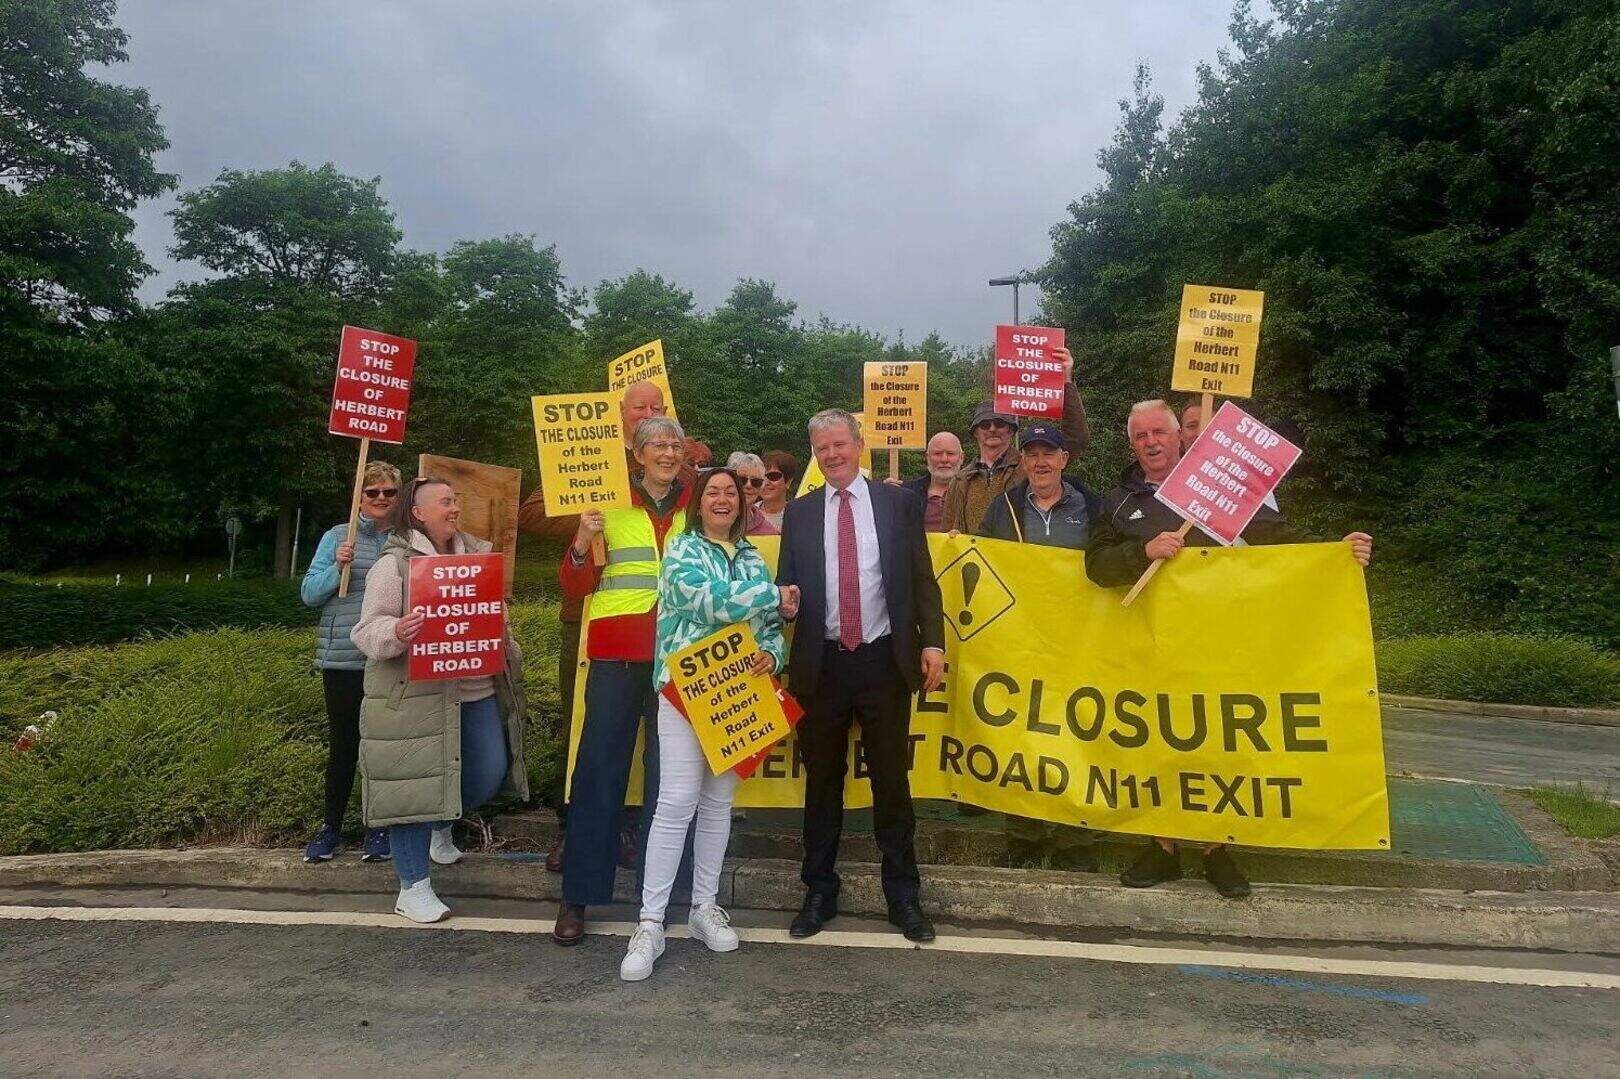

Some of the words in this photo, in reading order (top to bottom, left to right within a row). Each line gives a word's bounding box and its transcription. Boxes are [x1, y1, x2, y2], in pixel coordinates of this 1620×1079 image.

[1209, 293, 1237, 305] STOP
[1189, 308, 1207, 319] the
[1209, 310, 1252, 323] Closure
[1012, 334, 1048, 345] STOP
[1203, 326, 1215, 336] of
[1216, 327, 1233, 338] the
[360, 339, 399, 355] STOP
[1016, 348, 1043, 357] THE
[1194, 342, 1239, 357] Herbert
[364, 355, 393, 370] THE
[615, 349, 655, 376] STOP
[998, 359, 1062, 372] CLOSURE
[1189, 360, 1219, 373] Road
[1221, 363, 1240, 375] N11
[612, 378, 625, 391] THE
[627, 364, 662, 384] CLOSURE
[882, 365, 908, 376] STOP
[1021, 374, 1039, 382] OF
[340, 367, 409, 390] CLOSURE
[871, 382, 884, 390] the
[886, 382, 919, 390] Closure
[1202, 378, 1222, 391] Exit
[364, 389, 384, 400] OF
[998, 385, 1062, 399] HERBERT
[883, 396, 892, 404] of
[893, 396, 906, 404] the
[1011, 400, 1048, 411] ROAD
[335, 400, 404, 420] HERBERT
[544, 401, 609, 423] STOP
[878, 407, 912, 416] Herbert
[349, 418, 387, 432] ROAD
[875, 421, 897, 431] Road
[900, 421, 914, 431] N11
[541, 429, 563, 444] THE
[567, 425, 618, 441] CLOSURE
[887, 436, 902, 445] Exit
[1236, 417, 1279, 449] STOP
[562, 446, 575, 457] of
[581, 445, 601, 455] the
[1212, 429, 1232, 447] the
[1231, 442, 1274, 476] Closure
[558, 460, 609, 473] Herbert
[1216, 455, 1231, 468] of
[1228, 462, 1248, 480] the
[569, 476, 602, 488] Road
[1200, 460, 1247, 497] Herbert
[559, 493, 585, 505] N11
[591, 491, 616, 502] Exit
[1185, 474, 1219, 501] Road
[1215, 494, 1238, 515] N11
[1187, 500, 1212, 522] Exit
[433, 566, 481, 579] STOP
[439, 585, 476, 598] THE
[445, 622, 469, 635] OF
[413, 639, 501, 656] HERBERT
[679, 633, 743, 677] STOP
[433, 658, 481, 672] ROAD
[683, 679, 708, 701] THE
[711, 692, 724, 707] of
[726, 681, 747, 697] the
[710, 692, 760, 725] Herbert
[972, 672, 1328, 752] CLOSURE
[725, 712, 757, 736] Road
[721, 737, 745, 758] N11
[749, 722, 775, 742] Exit
[939, 735, 1069, 795] ROAD
[1085, 765, 1161, 808] N11
[1179, 772, 1302, 818] EXIT
